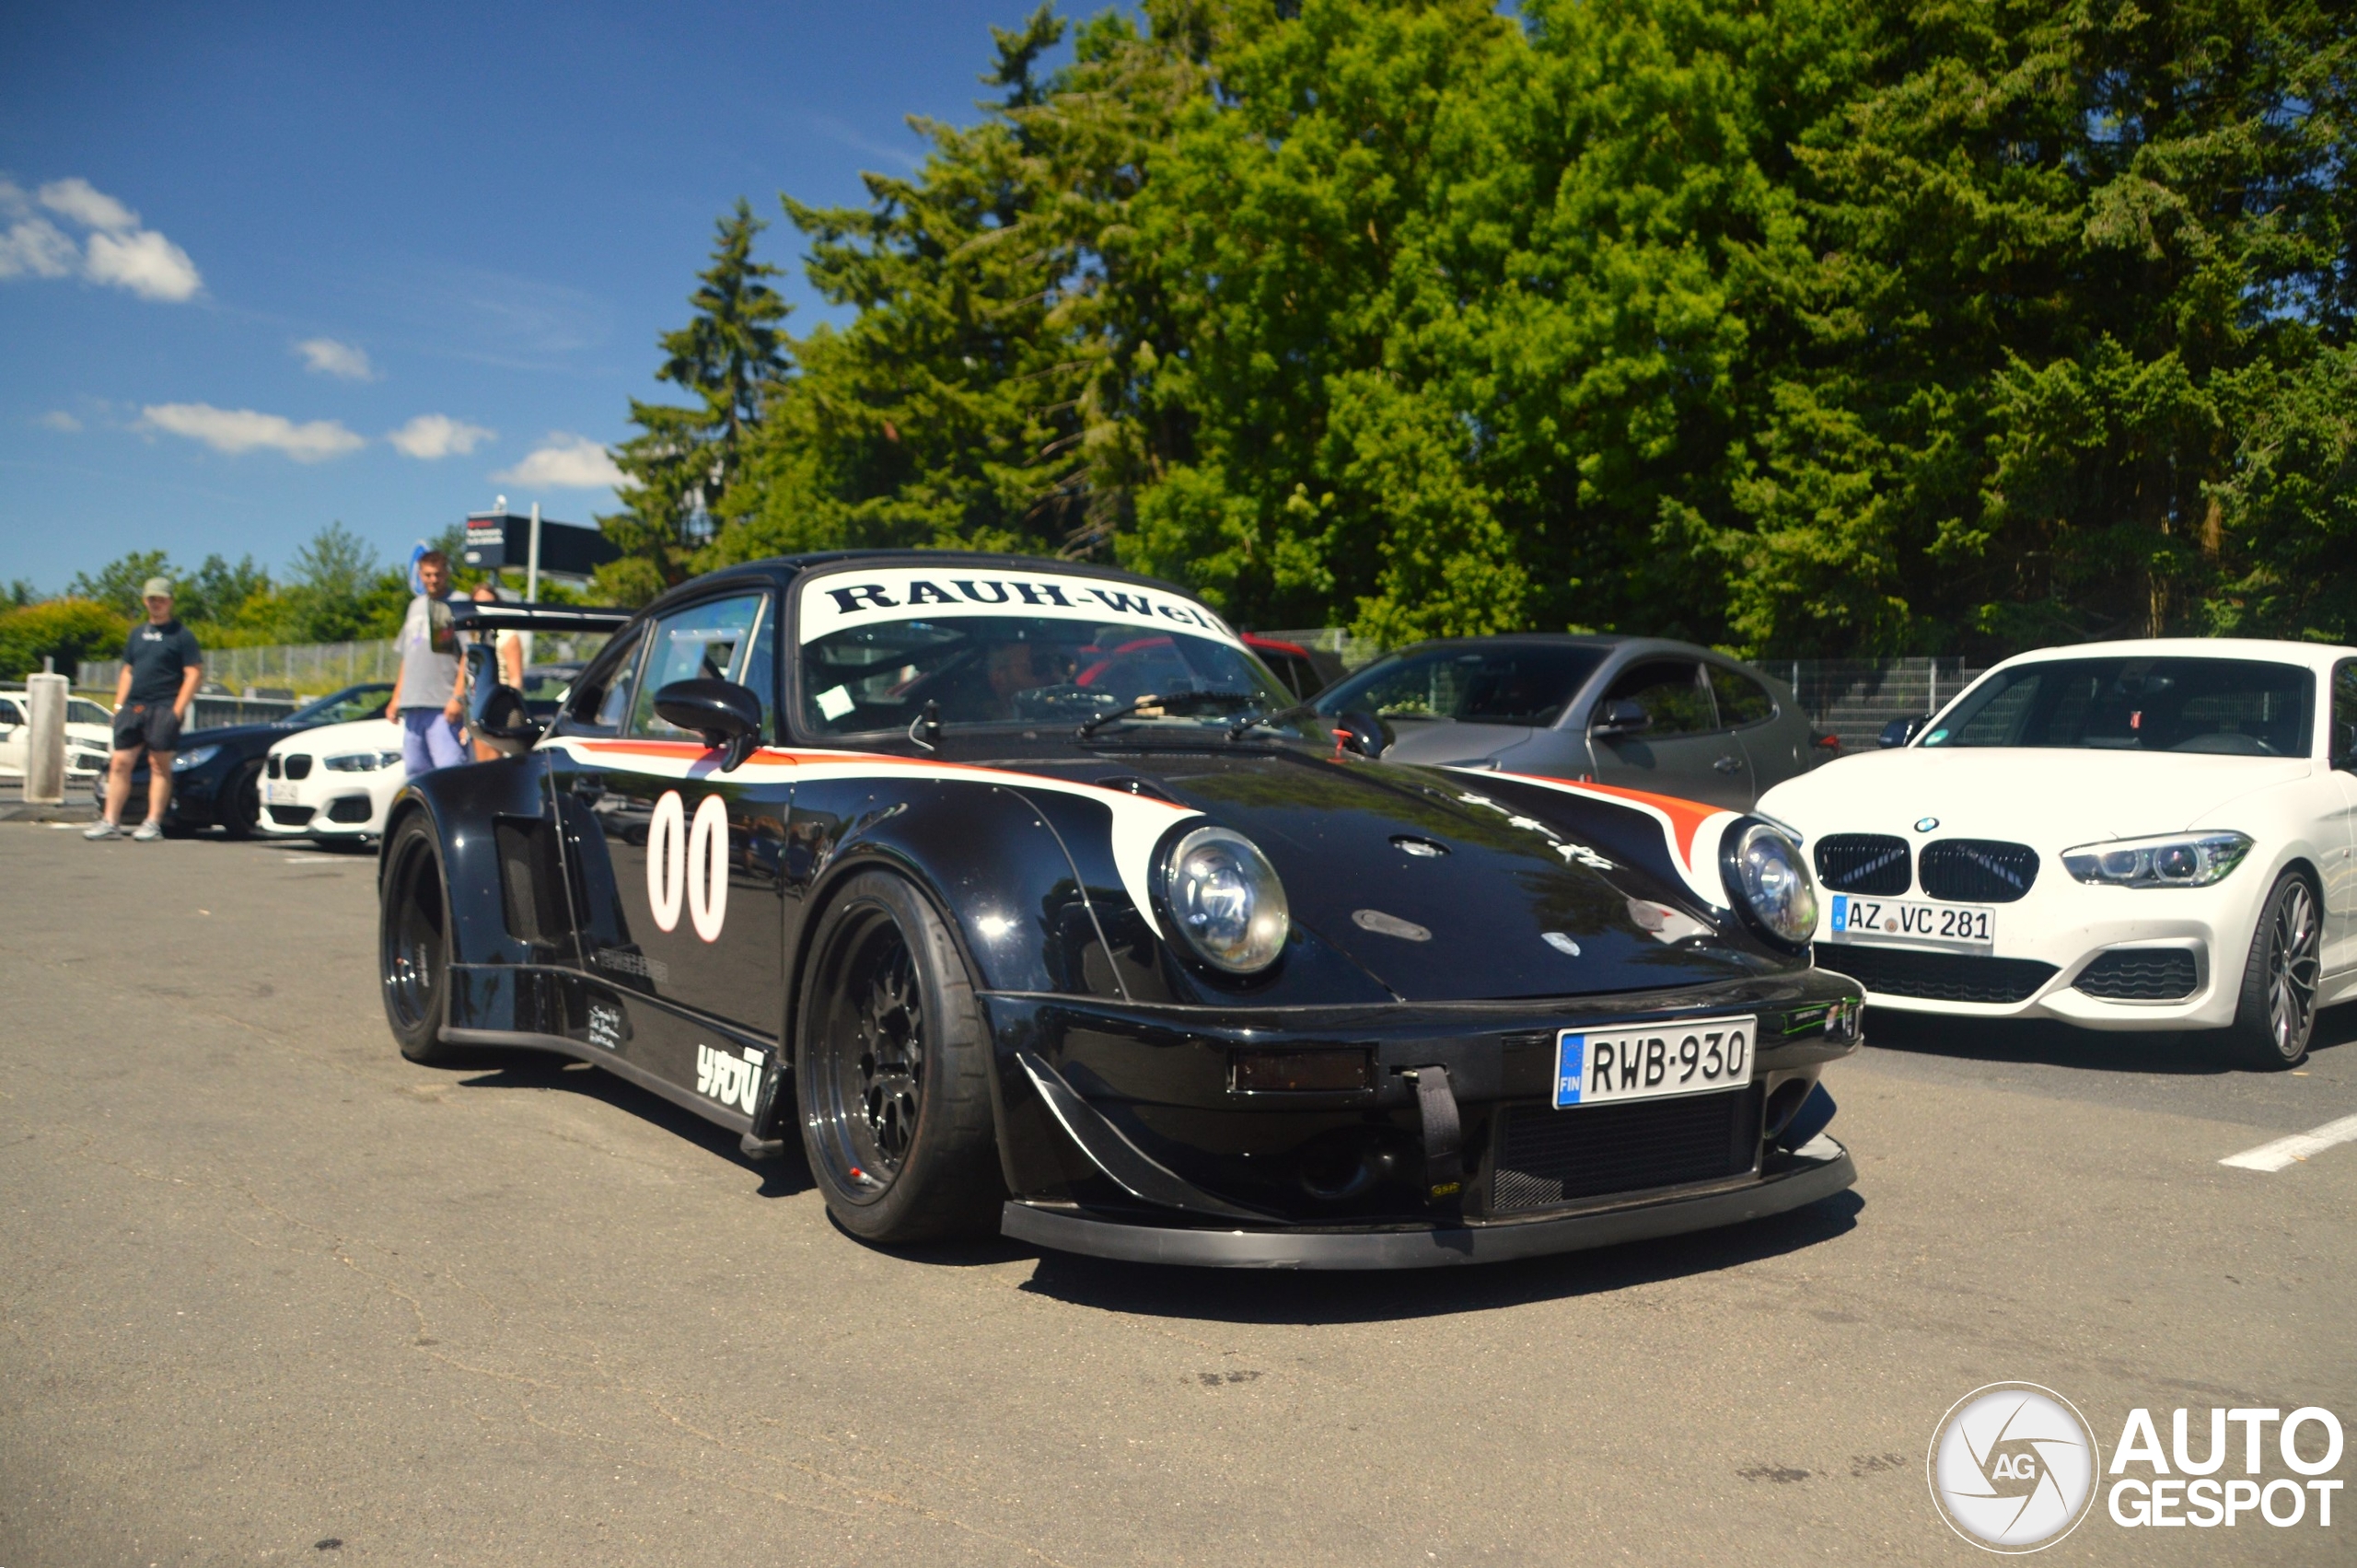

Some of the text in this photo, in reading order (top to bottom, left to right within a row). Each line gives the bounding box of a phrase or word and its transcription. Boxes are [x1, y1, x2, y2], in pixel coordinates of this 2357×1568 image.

[647, 790, 729, 943] 00
[1848, 902, 1990, 940] AZ VC 281
[1560, 1075, 1580, 1092] FIN
